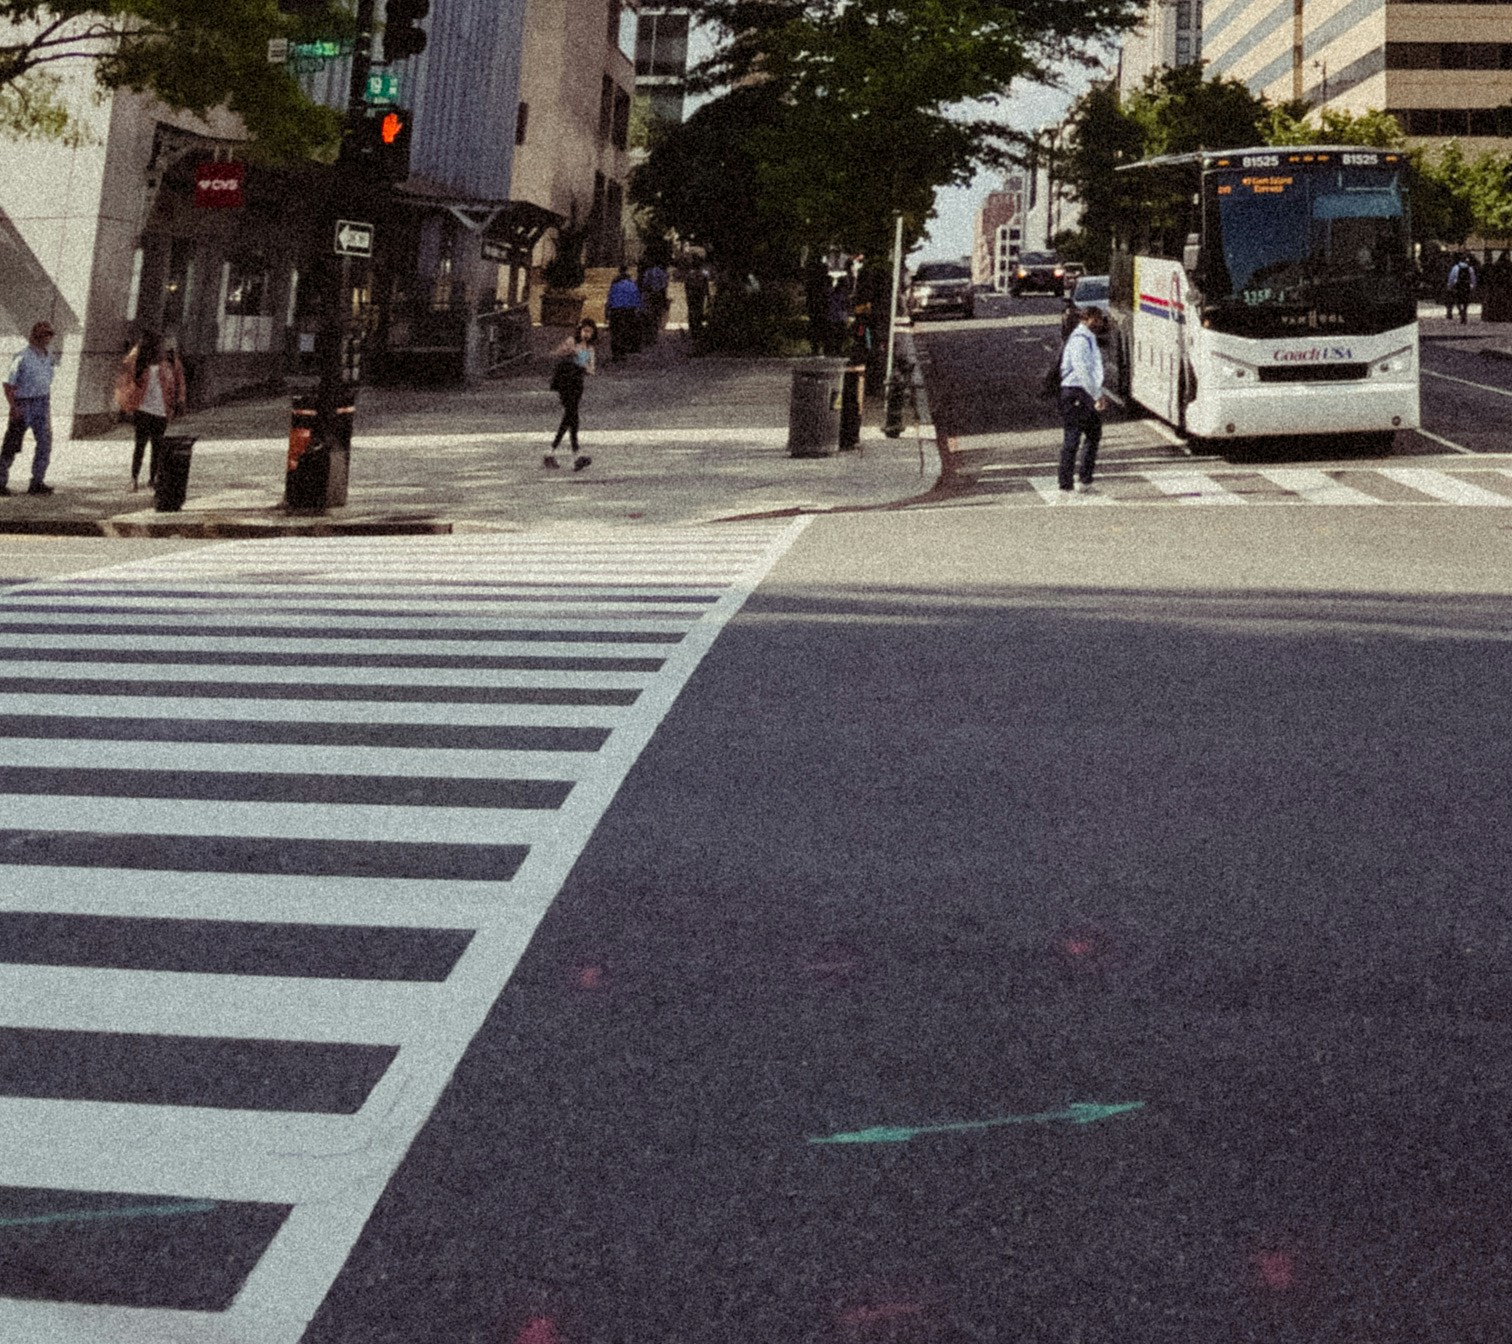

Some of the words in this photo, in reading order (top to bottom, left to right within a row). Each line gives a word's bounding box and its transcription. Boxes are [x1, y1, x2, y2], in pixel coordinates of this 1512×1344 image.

[1242, 155, 1279, 168] 81525
[1342, 153, 1378, 165] 81525
[211, 179, 238, 190] CVS
[1273, 346, 1320, 362] Coach
[1321, 346, 1353, 360] USA
